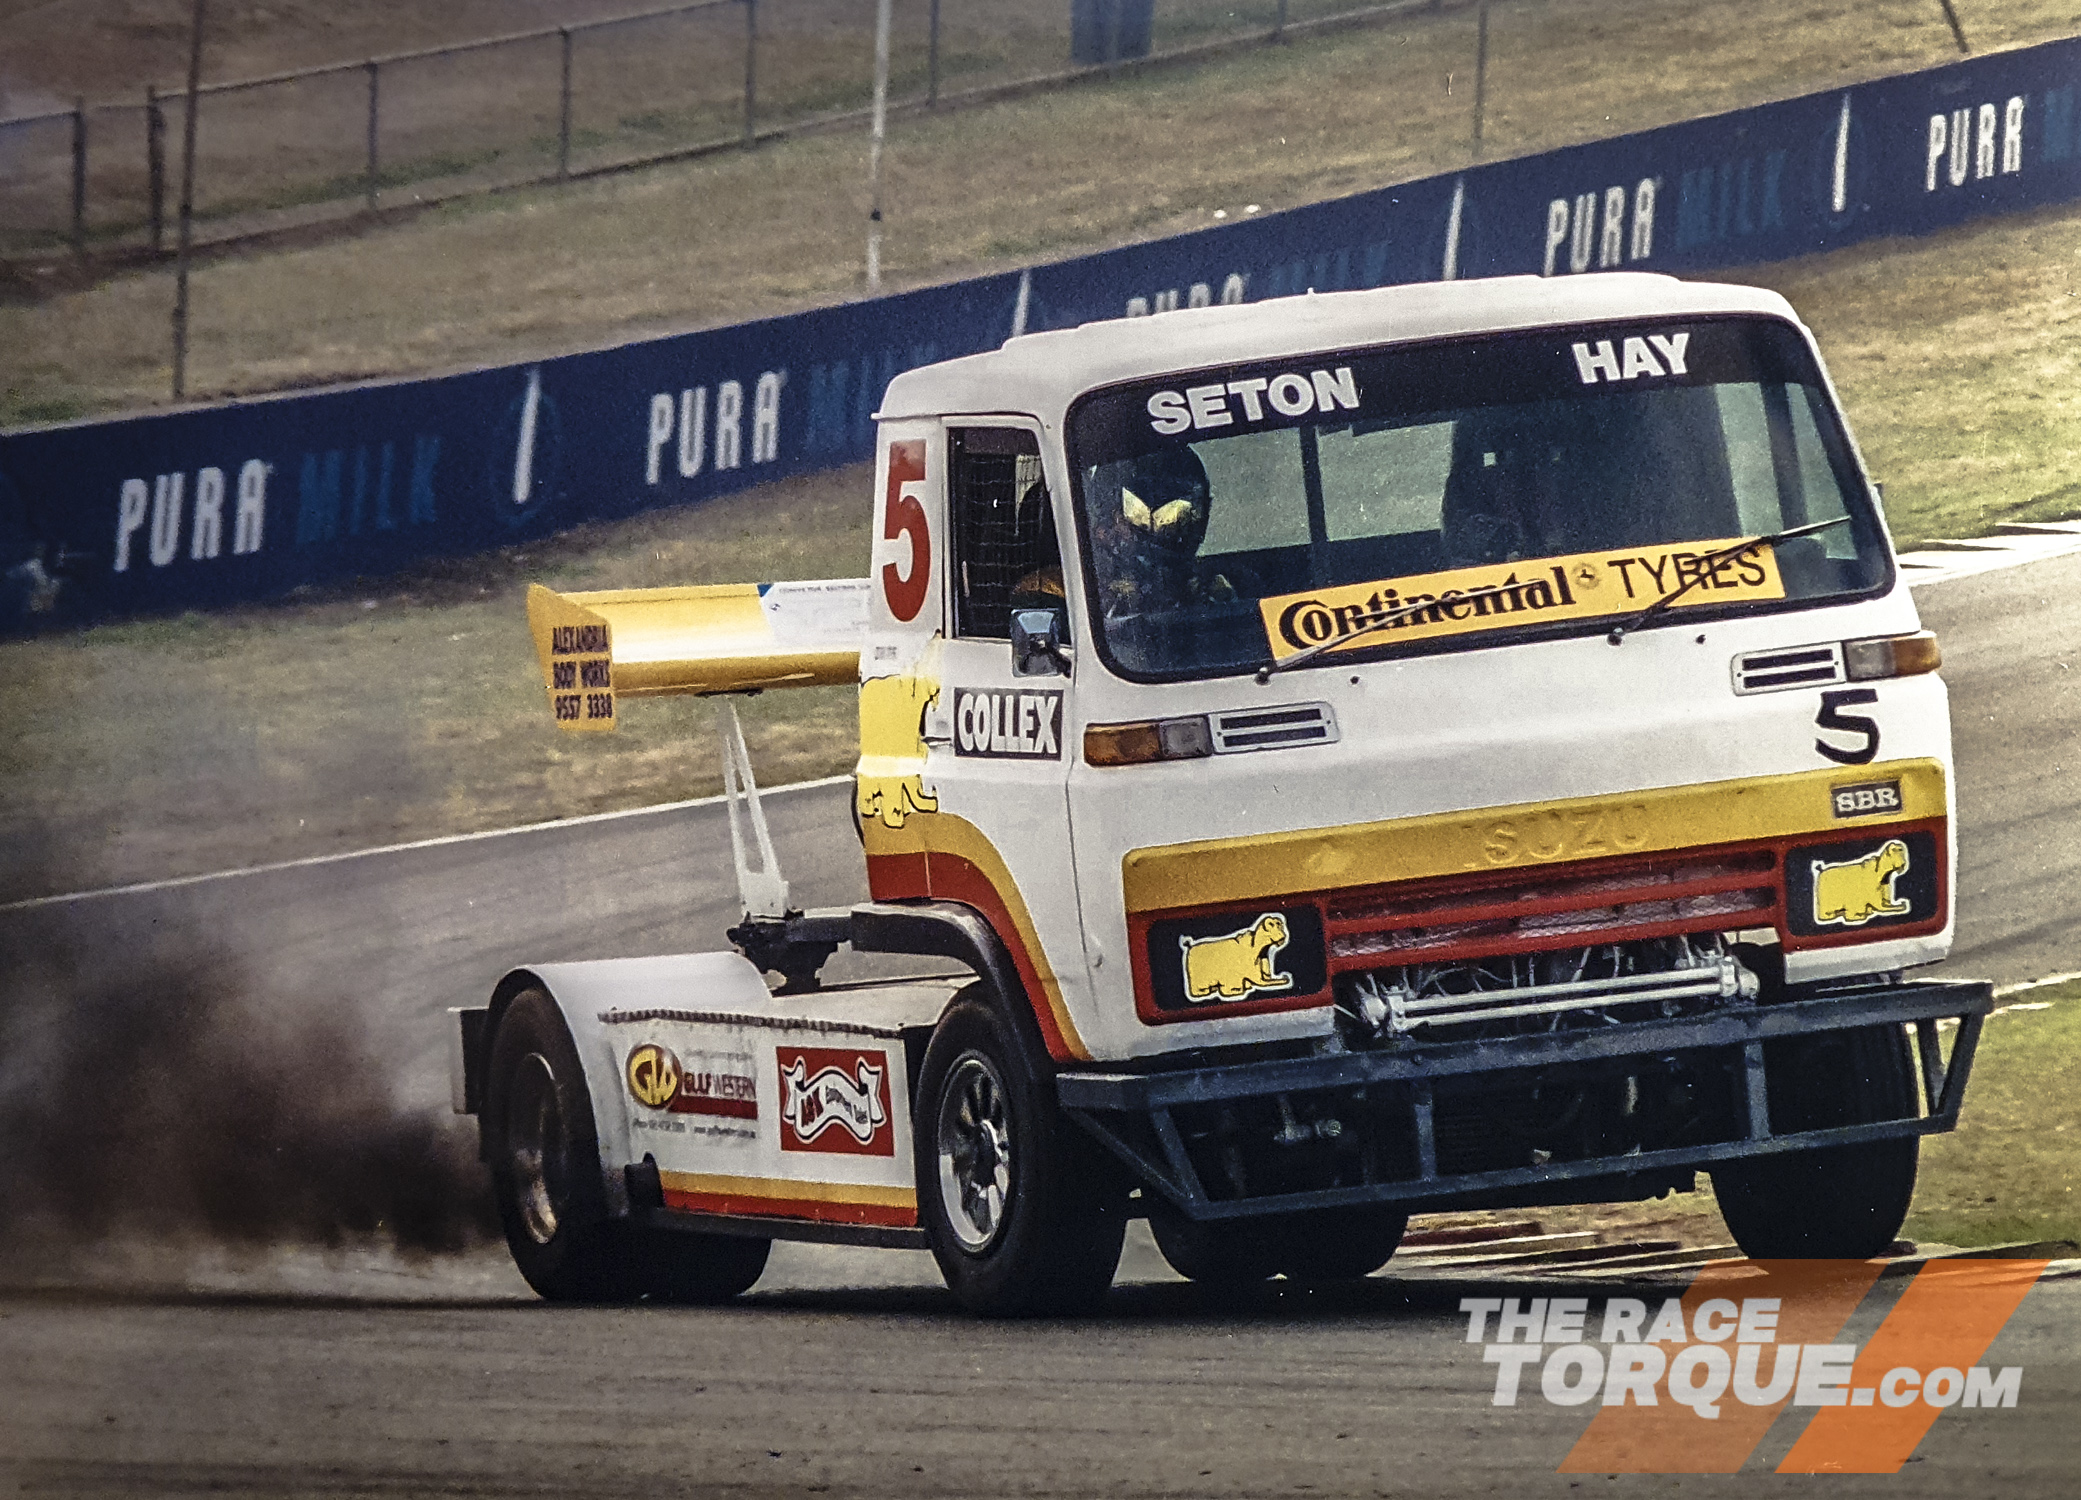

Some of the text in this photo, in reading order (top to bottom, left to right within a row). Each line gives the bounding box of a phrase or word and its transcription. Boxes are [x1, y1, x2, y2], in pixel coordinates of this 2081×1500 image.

[1926, 96, 2023, 192] PURA
[1544, 178, 1658, 276] PURA
[1147, 367, 1360, 435] SETON
[1571, 333, 1690, 384] HAY
[646, 371, 782, 485] PURA
[115, 459, 267, 572] PURA
[882, 439, 930, 622] 5
[1279, 547, 1765, 652] Continental TYRES
[957, 692, 1059, 754] COLLEX
[1815, 688, 1880, 765] 5
[1836, 787, 1899, 813] SBR
